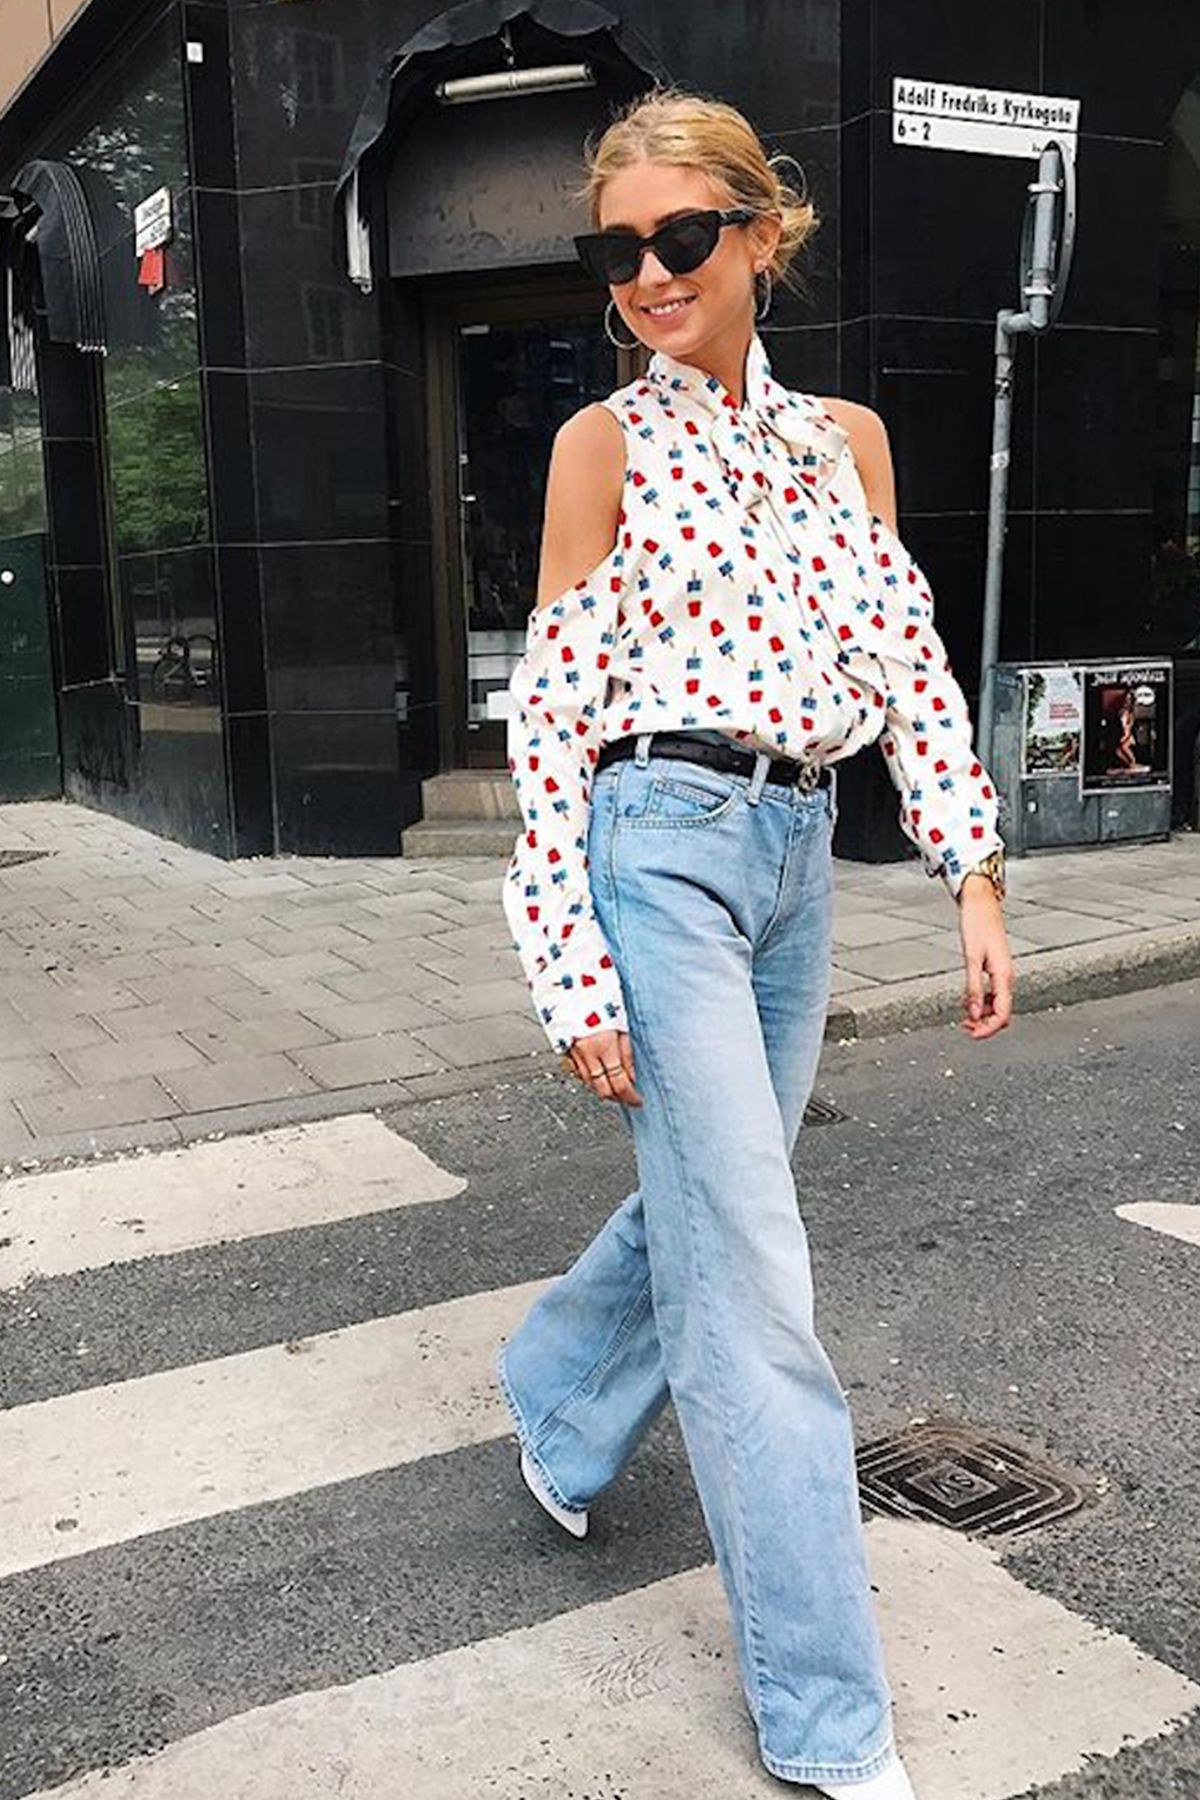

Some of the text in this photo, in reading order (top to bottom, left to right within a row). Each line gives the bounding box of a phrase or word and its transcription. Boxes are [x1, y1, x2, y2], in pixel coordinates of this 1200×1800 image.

[898, 86, 936, 108] Adolf
[942, 91, 998, 116] Fredriks
[898, 119, 906, 137] 6
[923, 122, 931, 141] 2
